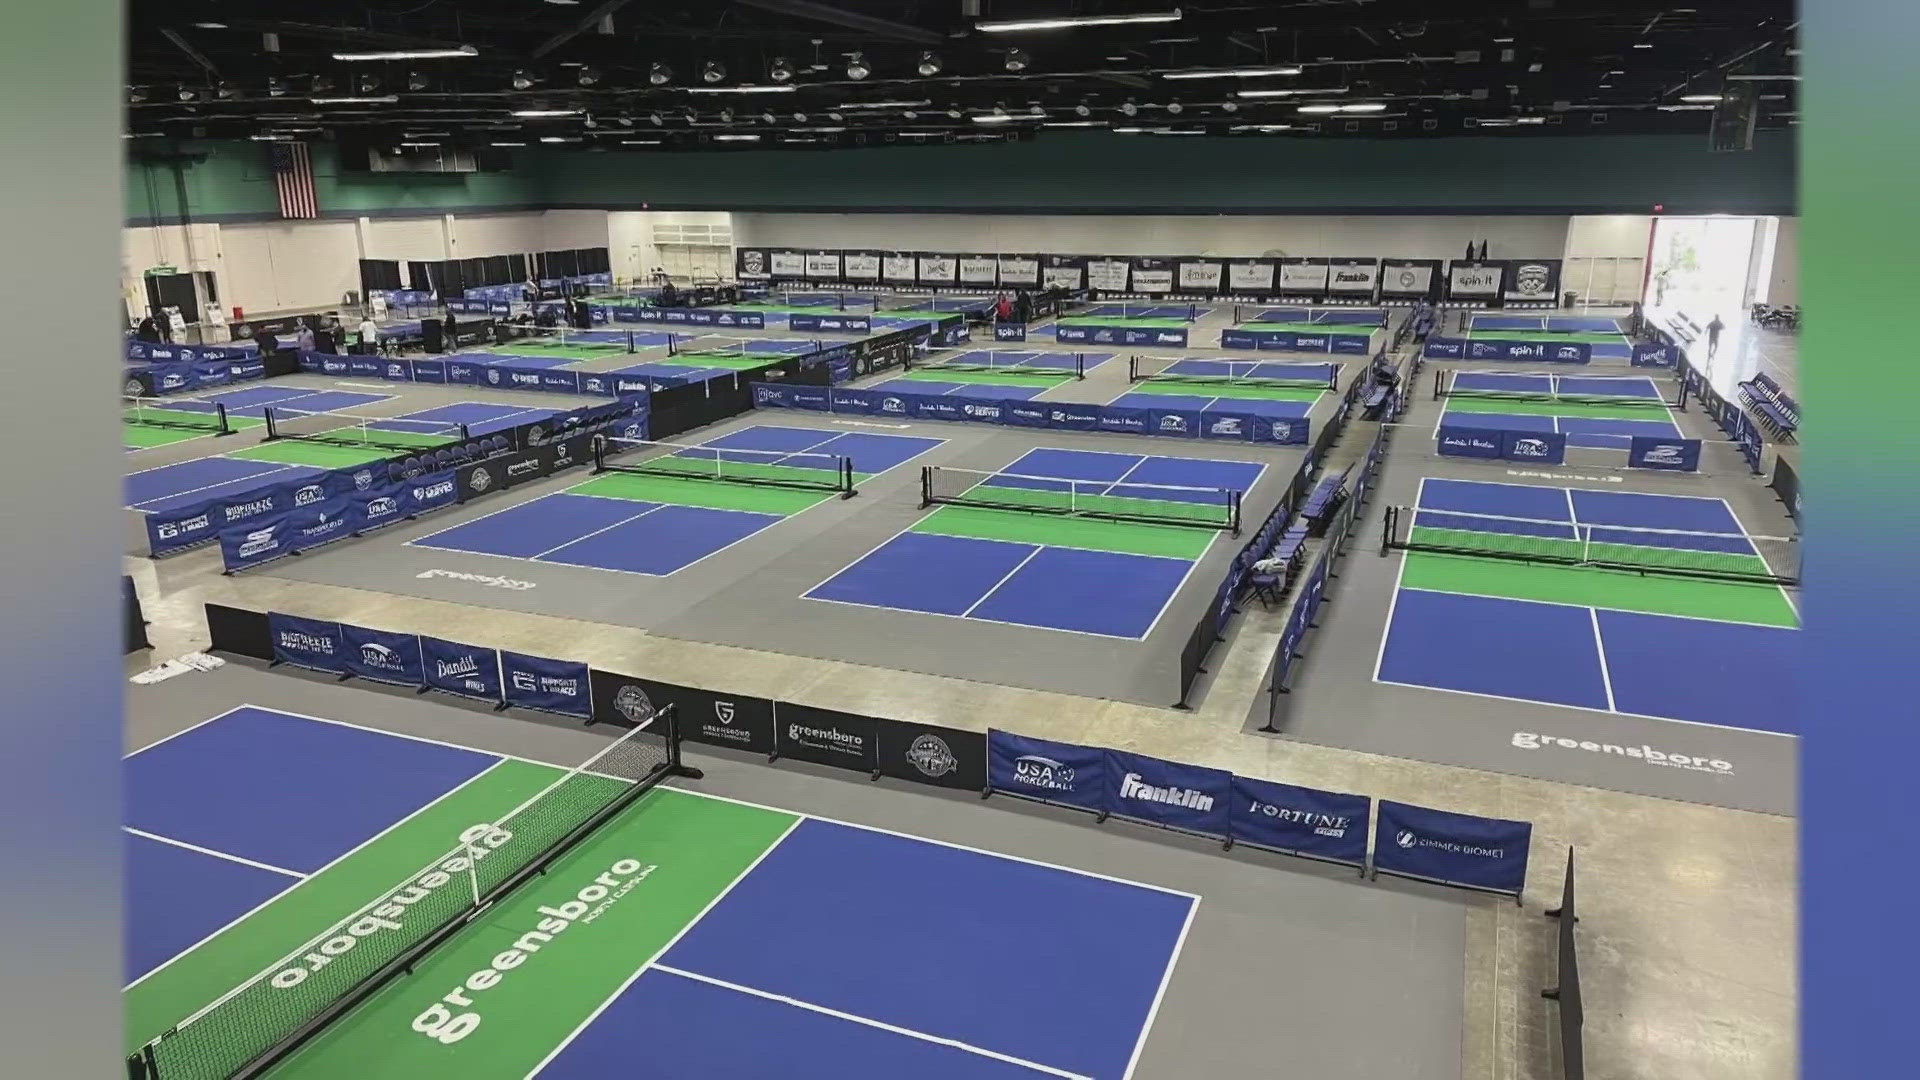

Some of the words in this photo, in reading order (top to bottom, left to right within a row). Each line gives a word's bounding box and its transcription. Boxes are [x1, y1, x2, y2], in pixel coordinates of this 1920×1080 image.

[437, 654, 479, 679] Bandit
[789, 723, 863, 745] greensboro
[1511, 731, 1734, 771] greensboro
[1013, 773, 1076, 792] PICKLEBALL
[1017, 761, 1053, 781] USA
[1120, 772, 1215, 813] franklin
[1249, 800, 1351, 830] FORTUNE
[270, 822, 514, 989] greensboro
[411, 858, 642, 1045] greensboro
